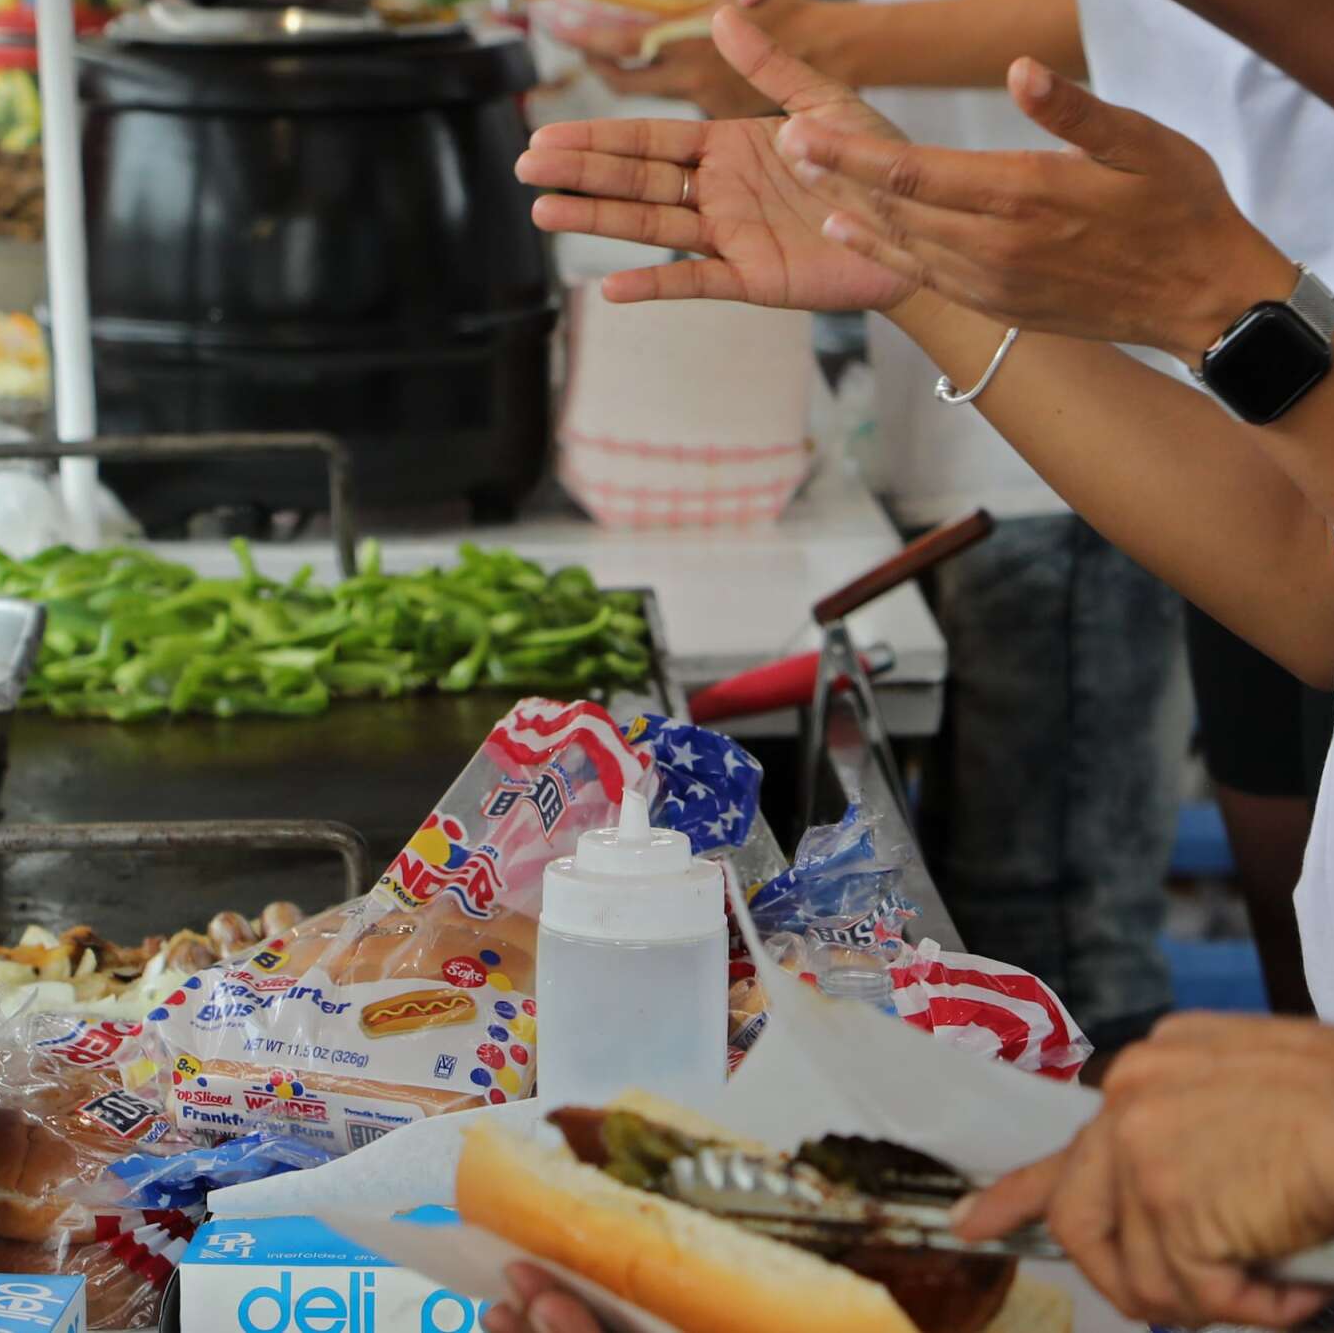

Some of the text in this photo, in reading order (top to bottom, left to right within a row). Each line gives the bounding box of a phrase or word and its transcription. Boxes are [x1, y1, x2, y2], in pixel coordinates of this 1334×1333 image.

[243, 1037, 369, 1067] NET WT 11.5 OZ (326g)
[176, 1058, 197, 1075] 8ct
[175, 1089, 233, 1106] op Sliced
[238, 1272, 375, 1333] deli
